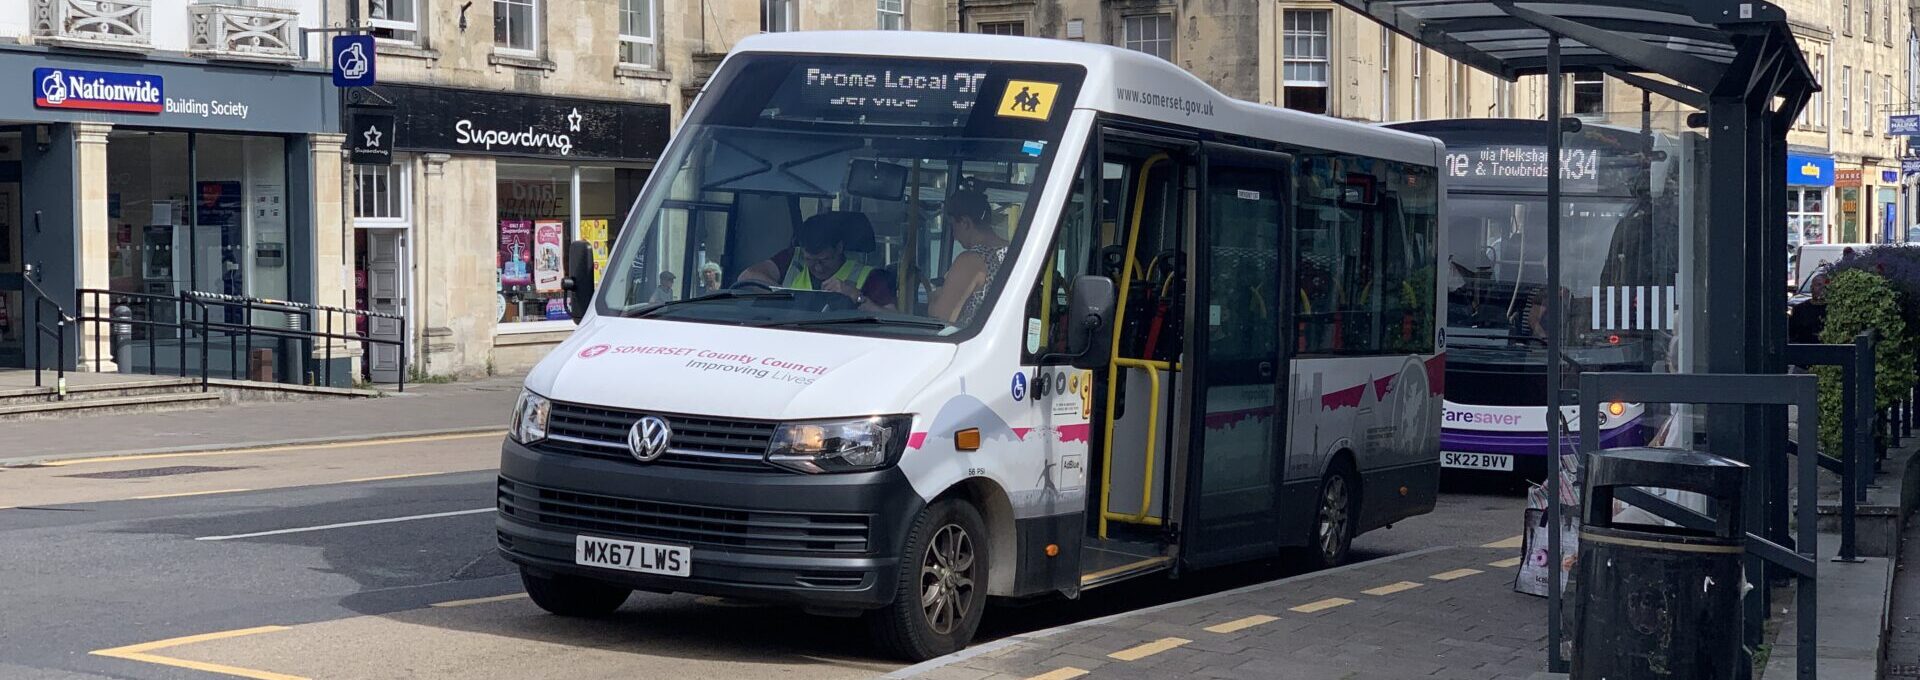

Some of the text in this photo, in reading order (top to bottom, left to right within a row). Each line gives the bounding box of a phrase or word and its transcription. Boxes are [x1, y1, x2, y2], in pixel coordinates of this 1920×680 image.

[69, 76, 160, 103] Nationwide
[806, 68, 877, 87] Frome
[884, 70, 948, 90] Local
[165, 98, 249, 119] Building Society
[1117, 87, 1214, 116] www.somerset.gov.uk
[455, 119, 573, 155] Superdrug
[1891, 121, 1918, 129] HALIFAX
[1480, 148, 1496, 161] via
[1559, 149, 1597, 180] X34
[1475, 162, 1487, 176] &
[610, 345, 828, 376] SOMERSET County Council
[686, 359, 816, 386] Improving Lives
[1063, 460, 1080, 469] AdBlue
[1445, 453, 1507, 469] SK22 BVV
[584, 541, 681, 572] MX67 LWS
